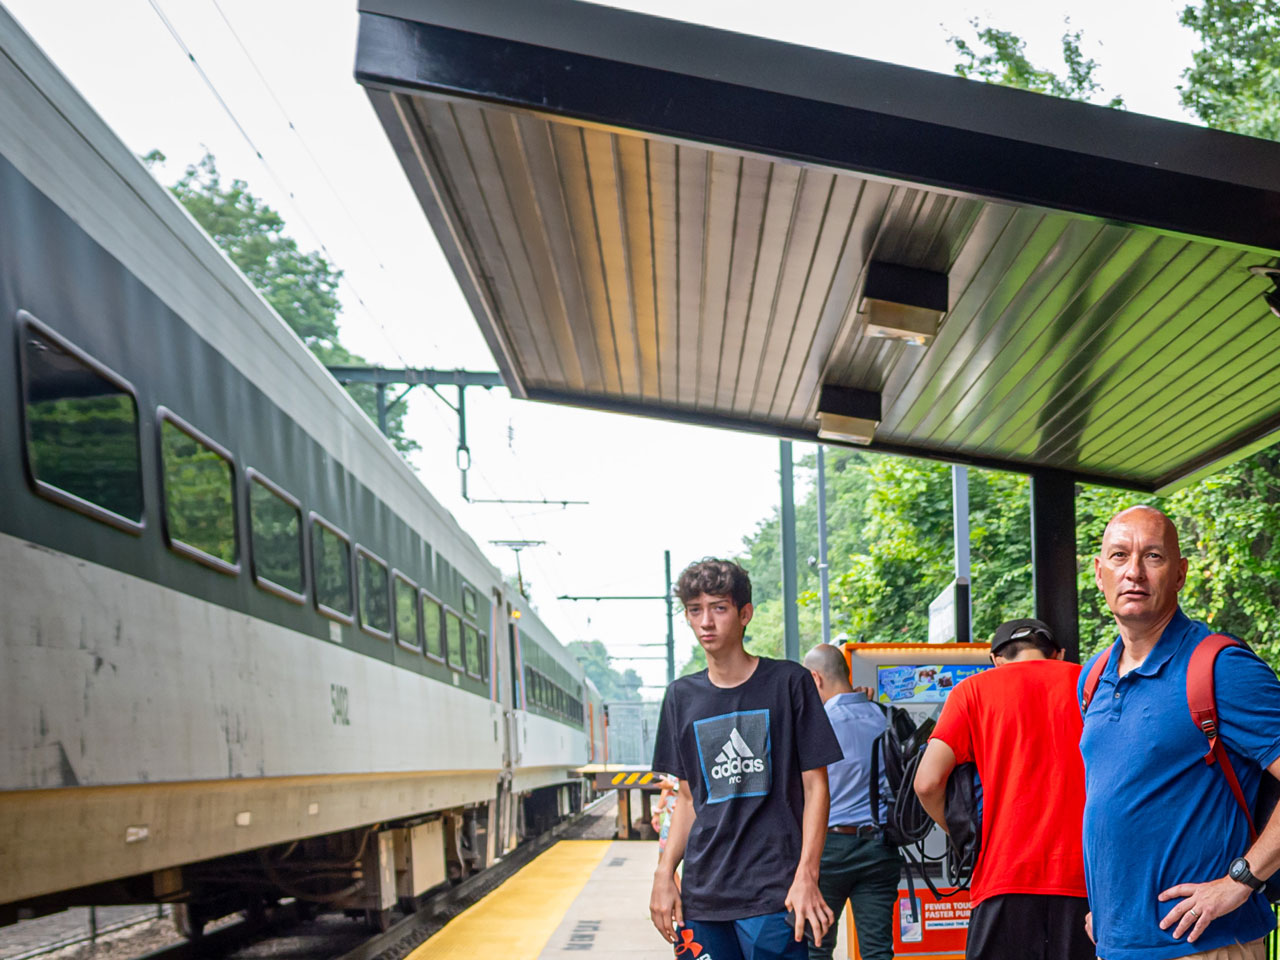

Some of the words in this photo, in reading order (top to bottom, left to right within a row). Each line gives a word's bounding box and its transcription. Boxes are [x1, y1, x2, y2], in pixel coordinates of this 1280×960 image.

[711, 756, 765, 779] addas
[924, 902, 952, 911] FEWER
[925, 910, 954, 919] FASTER
